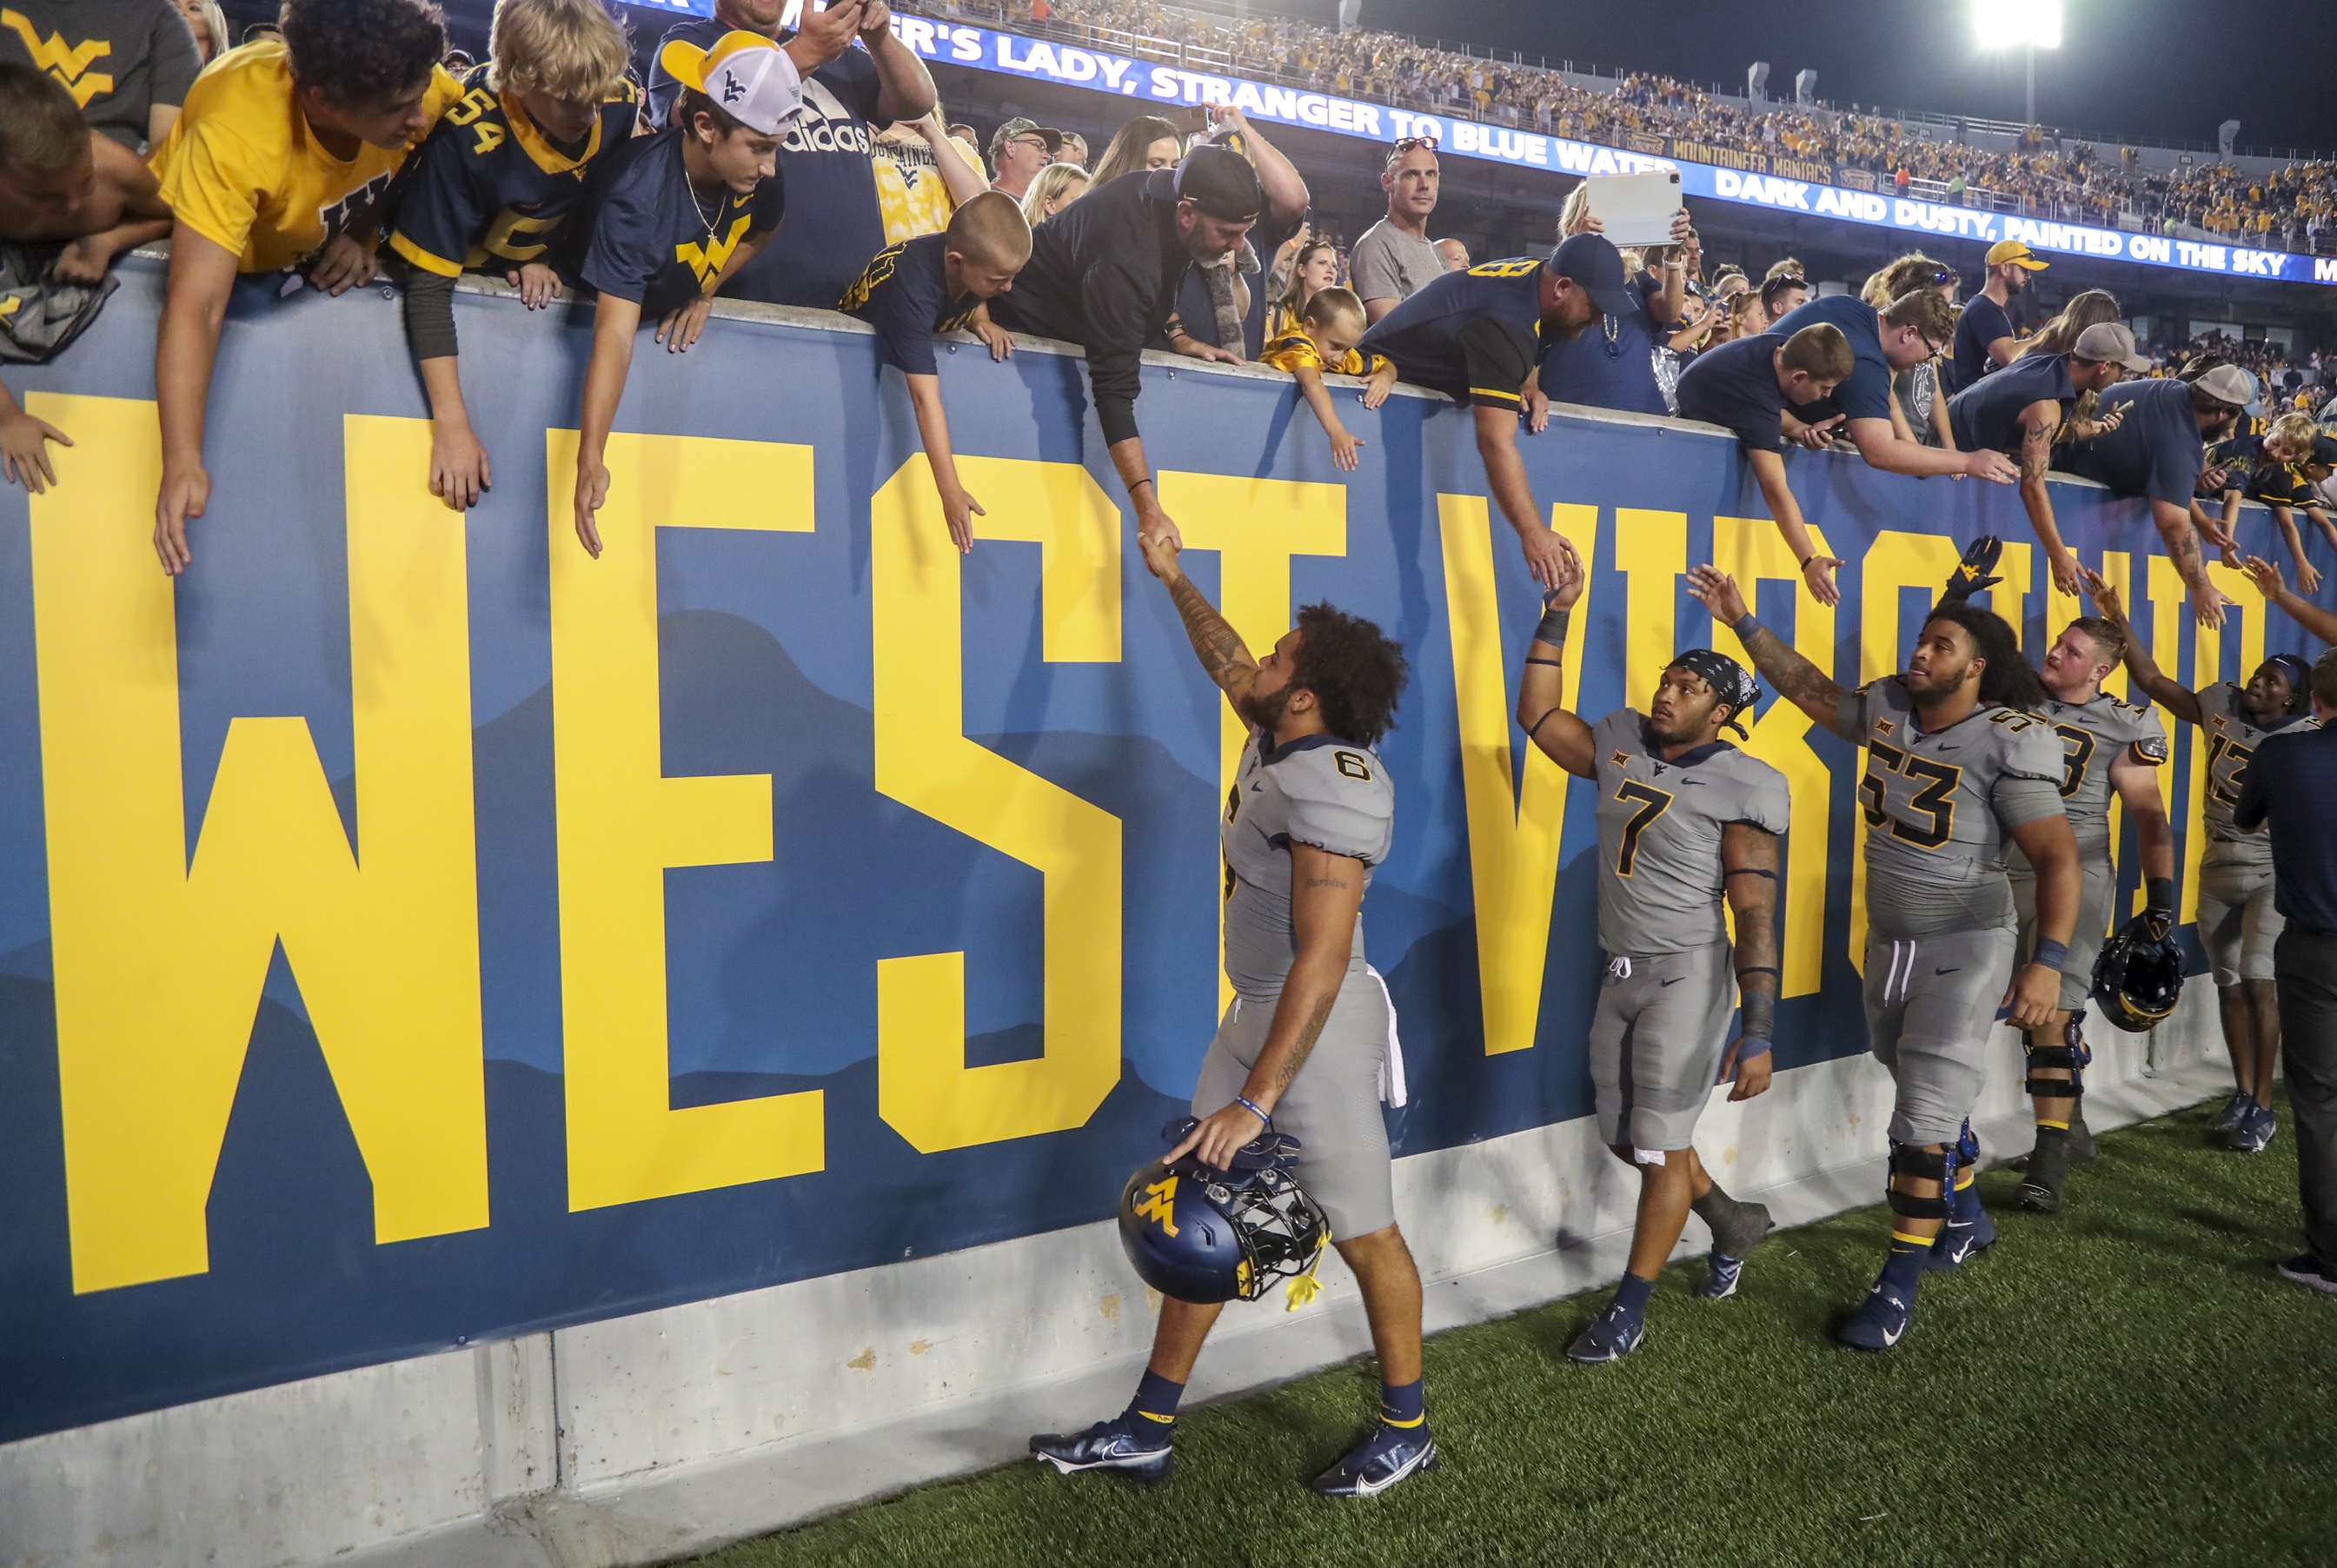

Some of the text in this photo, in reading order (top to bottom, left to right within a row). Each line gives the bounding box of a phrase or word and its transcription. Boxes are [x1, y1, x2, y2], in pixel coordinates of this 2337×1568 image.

[445, 87, 506, 155] 54
[781, 117, 870, 154] didas
[997, 36, 1138, 95] LADY,
[1151, 67, 1381, 136] STRANGER
[1389, 111, 1443, 143] TO
[1453, 122, 1548, 165] BLUE
[1716, 169, 1809, 210] DARK
[1815, 187, 1887, 222] AND
[1895, 200, 1997, 241] DUSTY,
[2003, 216, 2122, 256] PAINTED
[2128, 234, 2171, 263] ON
[2176, 241, 2227, 270] THE
[2232, 249, 2287, 276] SKY
[1332, 749, 1371, 781] 6
[1858, 738, 1963, 850] 53
[24, 390, 1349, 1295] WEST
[1613, 777, 1676, 877] 7
